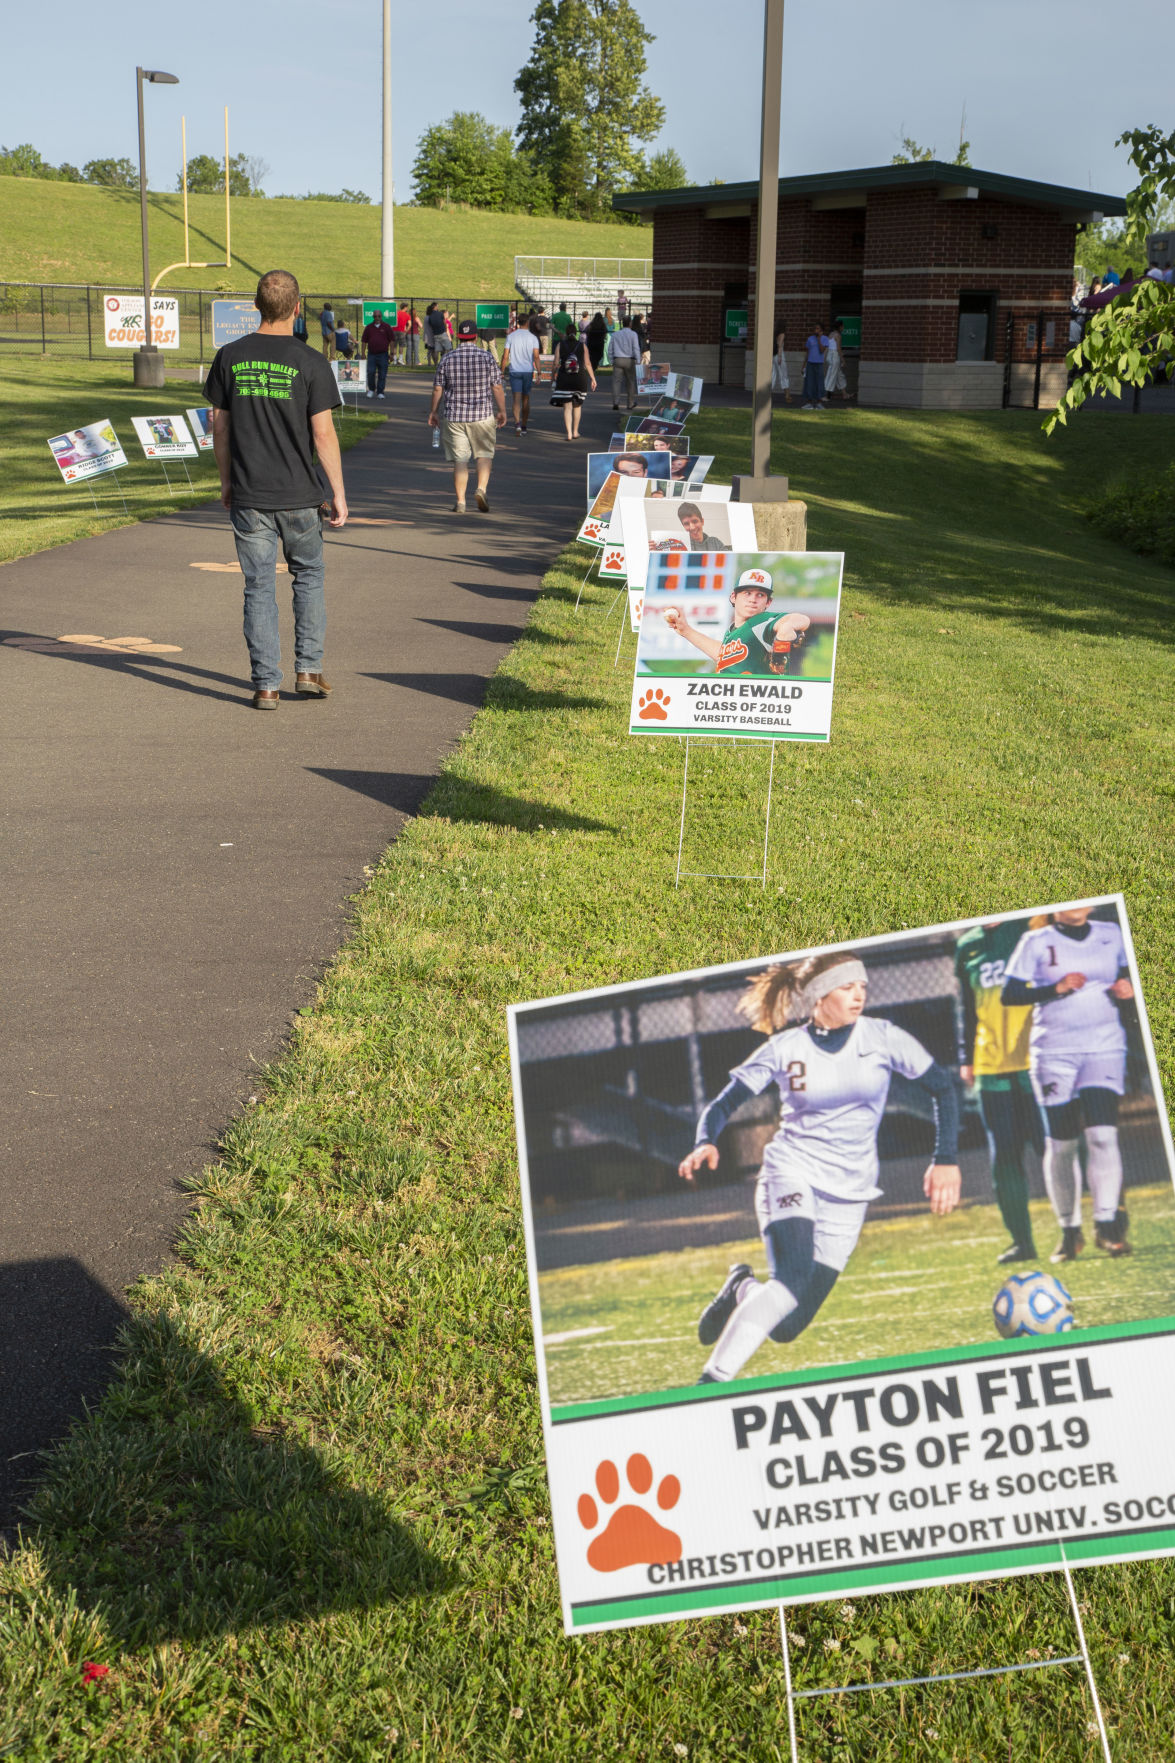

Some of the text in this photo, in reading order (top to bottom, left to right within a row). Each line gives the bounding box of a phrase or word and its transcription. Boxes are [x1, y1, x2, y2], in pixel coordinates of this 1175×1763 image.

[153, 301, 176, 311] SAYS
[108, 328, 176, 343] COUGRS!
[232, 361, 299, 377] BULL RUN VALLEY
[749, 571, 765, 583] KR
[687, 683, 803, 700] ZACH EWALD
[695, 701, 792, 714] CLASS OF 2019
[694, 714, 792, 726] VARSITY BASEBALL
[1046, 945, 1059, 967] 1
[979, 959, 1006, 989] 22
[787, 1060, 807, 1092] 2
[731, 1357, 1114, 1450] PAYTON FIEL
[766, 1416, 1090, 1489] CLASS OF 2019
[753, 1461, 1119, 1531] VARSITY GOLF & SOCCER
[647, 1537, 855, 1585] CHRISTOPHER
[859, 1516, 1005, 1557] NEWPORT
[1013, 1505, 1098, 1536] UNIV.
